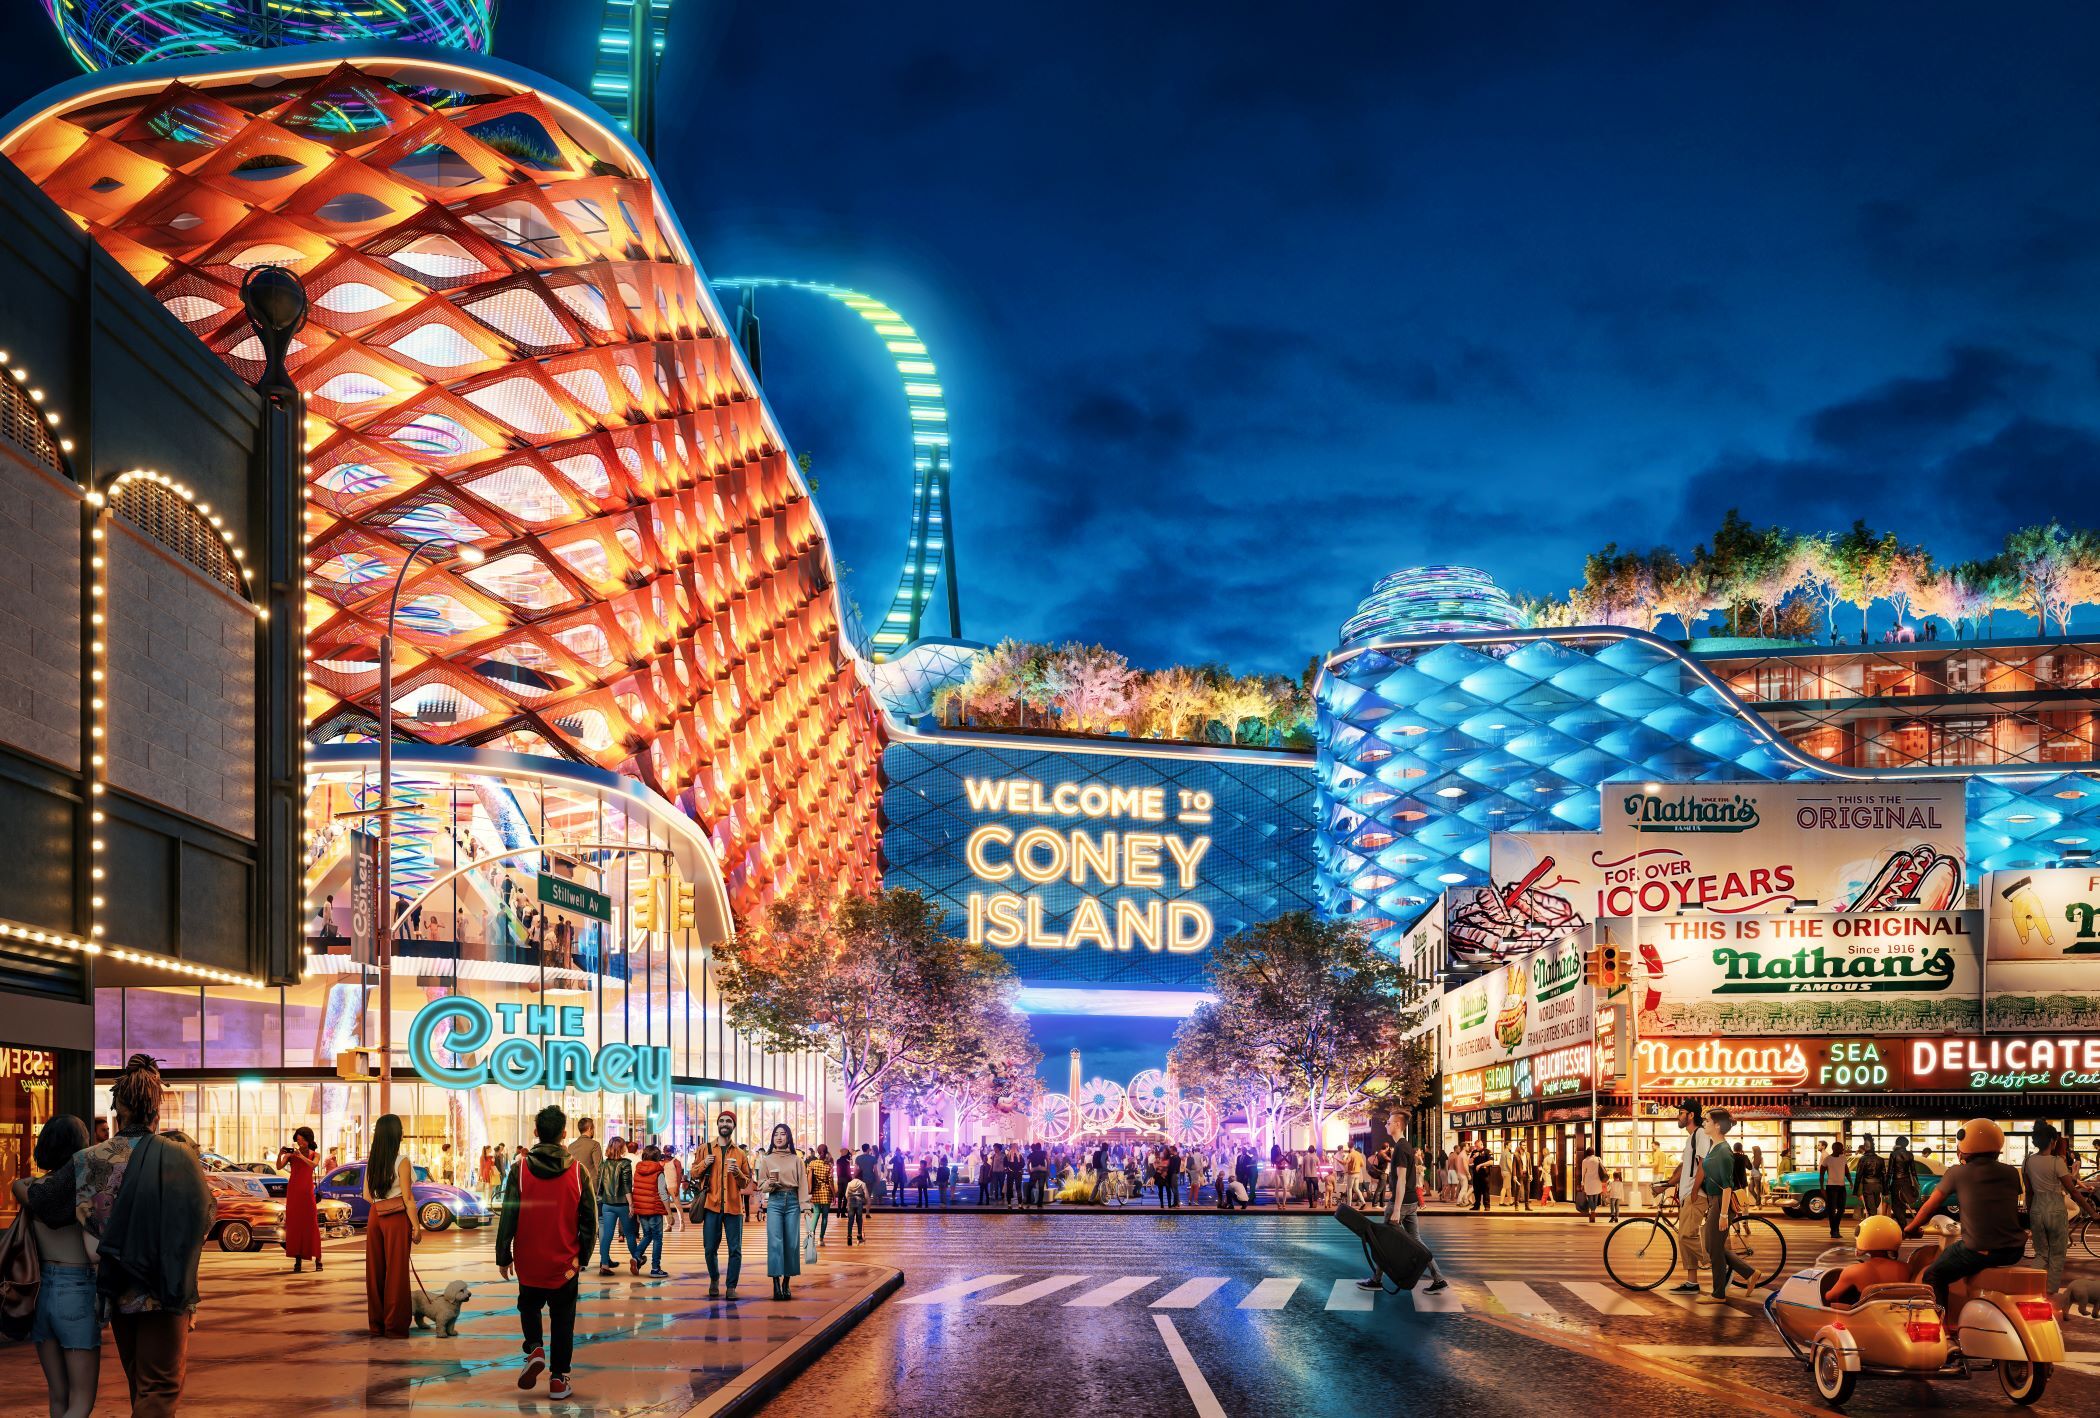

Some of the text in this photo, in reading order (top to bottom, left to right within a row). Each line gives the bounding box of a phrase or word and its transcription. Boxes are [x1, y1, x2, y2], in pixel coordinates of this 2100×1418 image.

[965, 778, 1213, 820] WELCOME TO
[1624, 794, 1759, 823] Nathan's
[1837, 795, 1902, 804] THIS IS THE
[1797, 806, 1942, 829] ORIGINAL
[966, 824, 1211, 889] CONEY
[1605, 860, 1692, 885] FOR OVER
[1670, 865, 1795, 903] YEARS
[353, 853, 373, 937] Coney
[552, 884, 598, 913] Stillwell Av
[968, 893, 1214, 954] ISLAND
[1665, 917, 1971, 940] THIS IS THE ORIGINAL
[1848, 944, 1915, 955] Since 1916
[1534, 943, 1580, 989] Nathan's
[1712, 946, 1956, 980] Nathan's
[1789, 982, 1873, 992] FAMOUS
[496, 1003, 585, 1036] THE
[1539, 996, 1575, 1022] WORLD FAMOUS
[1561, 1019, 1575, 1039] SINCE
[1577, 1015, 1589, 1034] 1916
[408, 996, 671, 1134] Coney
[1637, 1039, 1806, 1074] Nathan's
[1830, 1043, 1880, 1062] SEA
[1913, 1040, 2100, 1075] DELICATE
[1495, 1065, 1511, 1089] FOOD
[1534, 1045, 1591, 1087] DELICATESSEN
[1820, 1066, 1888, 1085] FOOD
[1521, 1075, 1533, 1098] BAR
[1674, 1078, 1746, 1087] FAMOUS
[1971, 1071, 2050, 1088] Buffet
[1465, 1112, 1477, 1126] CLAM
[1478, 1110, 1487, 1125] BAR
[1507, 1106, 1520, 1123] CLAM
[1521, 1104, 1533, 1121] BAR
